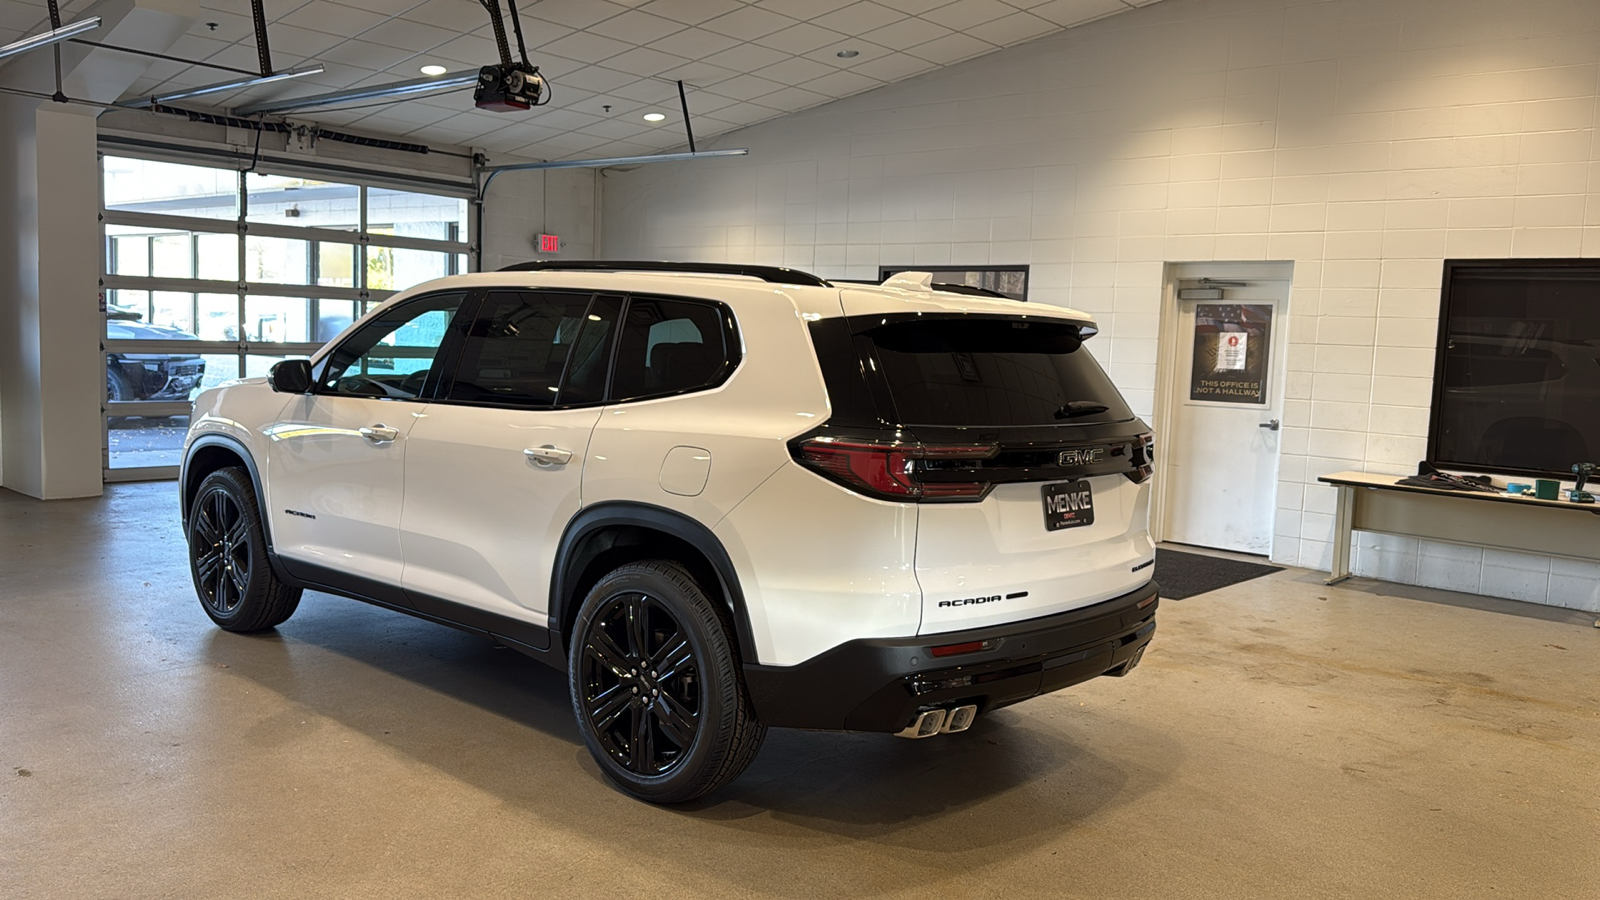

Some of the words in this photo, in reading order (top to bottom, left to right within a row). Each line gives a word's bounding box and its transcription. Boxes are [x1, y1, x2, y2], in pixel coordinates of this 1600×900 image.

[542, 235, 558, 252] EXIT
[1220, 381, 1250, 389] OFFICE
[1222, 388, 1261, 396] HALLWAY
[1059, 448, 1103, 466] GMC
[1046, 491, 1091, 514] MENKE
[938, 595, 1002, 607] ACADIA
